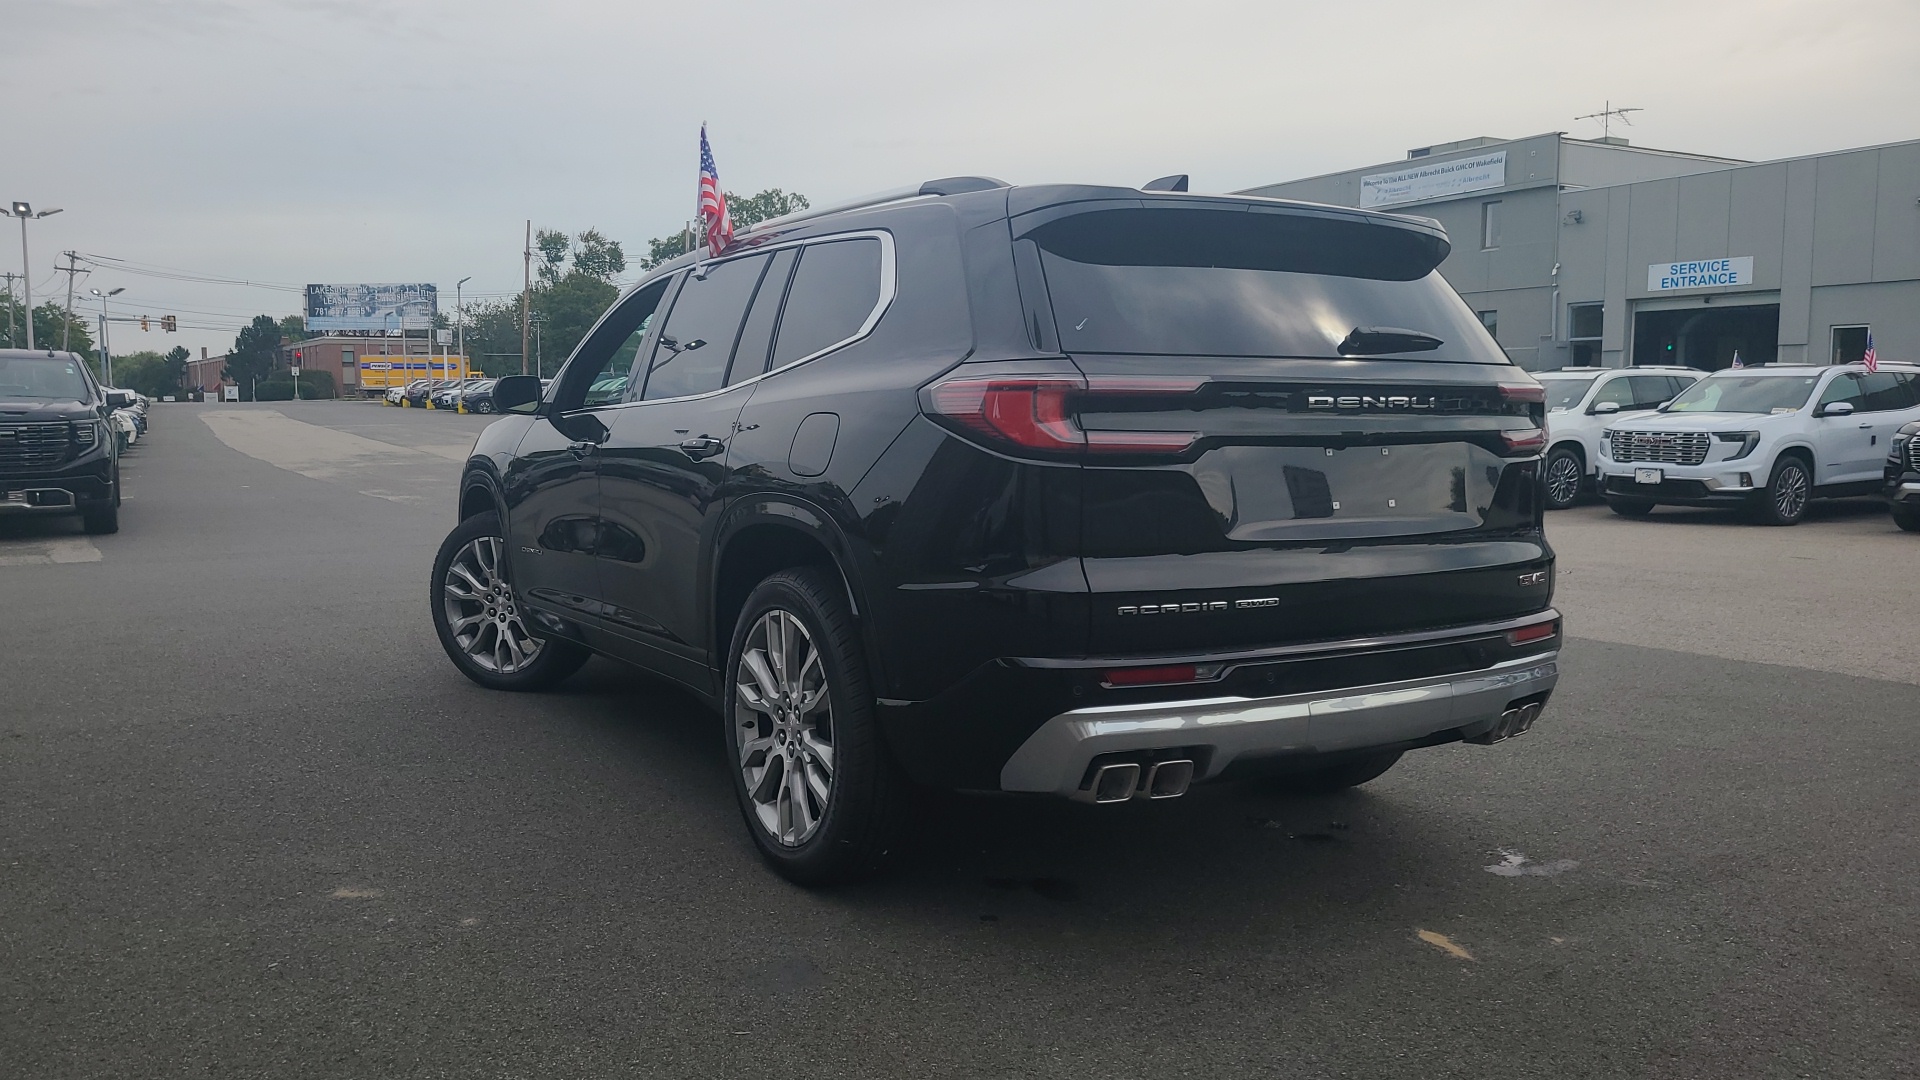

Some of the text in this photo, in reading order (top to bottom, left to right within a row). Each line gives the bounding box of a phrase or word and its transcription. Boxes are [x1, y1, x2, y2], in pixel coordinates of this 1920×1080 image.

[1408, 172, 1419, 180] NEW
[1419, 167, 1440, 178] Albrecht
[1441, 165, 1455, 174] Buick
[1455, 162, 1468, 171] GMC
[1468, 161, 1475, 169] Of
[1475, 157, 1503, 167] Wakefield
[1462, 174, 1490, 183] Albrecht
[1670, 260, 1730, 275] SERVICE
[1661, 272, 1737, 288] ENTRANCE
[1308, 396, 1435, 408] DENALI
[1117, 601, 1228, 616] ACADIA
